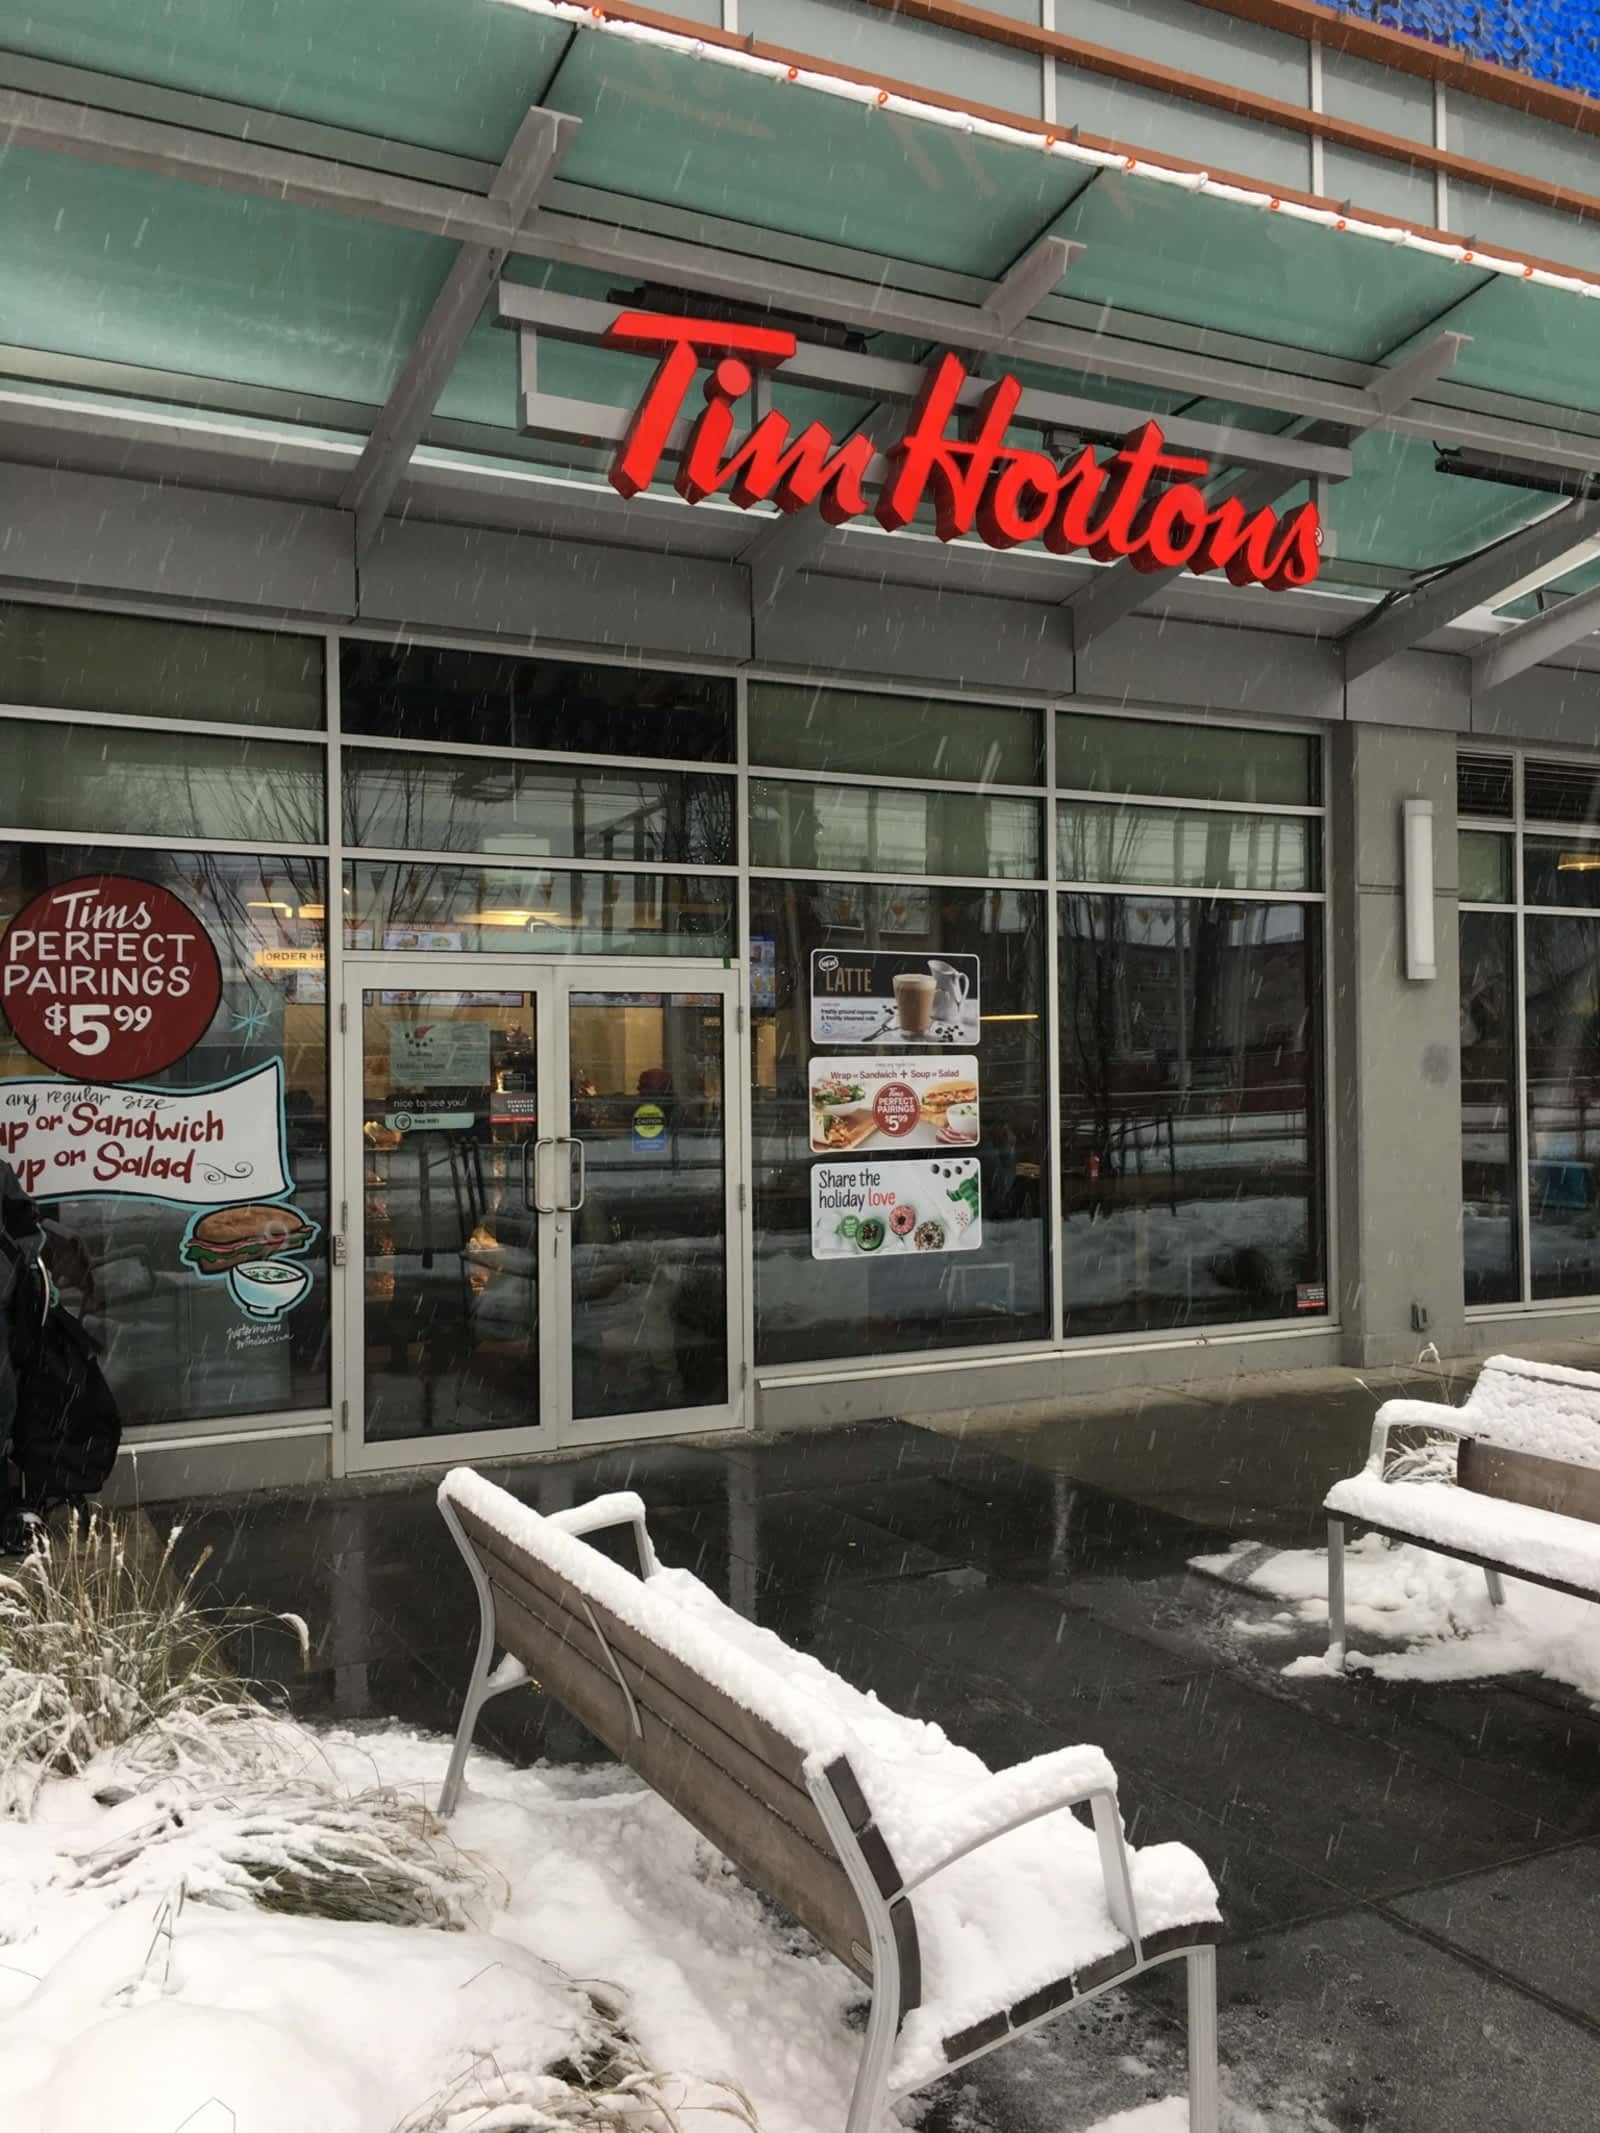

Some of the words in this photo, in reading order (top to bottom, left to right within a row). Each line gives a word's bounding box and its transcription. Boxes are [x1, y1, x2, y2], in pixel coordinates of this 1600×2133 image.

[603, 311, 878, 526] Tim
[874, 352, 1320, 591] Hortons
[53, 888, 151, 930] Tims
[10, 930, 195, 962] PERFECT
[266, 952, 307, 961] ORDER
[4, 964, 190, 996] PAIRINGS
[826, 967, 872, 993] LATTE
[830, 1071, 852, 1080] Wrap
[860, 1070, 897, 1079] Sandwich
[911, 1070, 930, 1079] Soup
[938, 1069, 960, 1078] Salad
[6, 1093, 39, 1115] any
[47, 1086, 111, 1112] regular
[877, 1104, 915, 1113] PAIRINGS
[878, 1096, 914, 1104] PERFECT
[36, 1115, 63, 1131] or
[68, 1102, 224, 1143] Sandwich
[54, 1150, 86, 1167] or
[93, 1141, 195, 1184] Salad
[818, 1169, 856, 1189] Share
[859, 1168, 880, 1186] the
[819, 1188, 865, 1212] holiday
[868, 1187, 895, 1206] love
